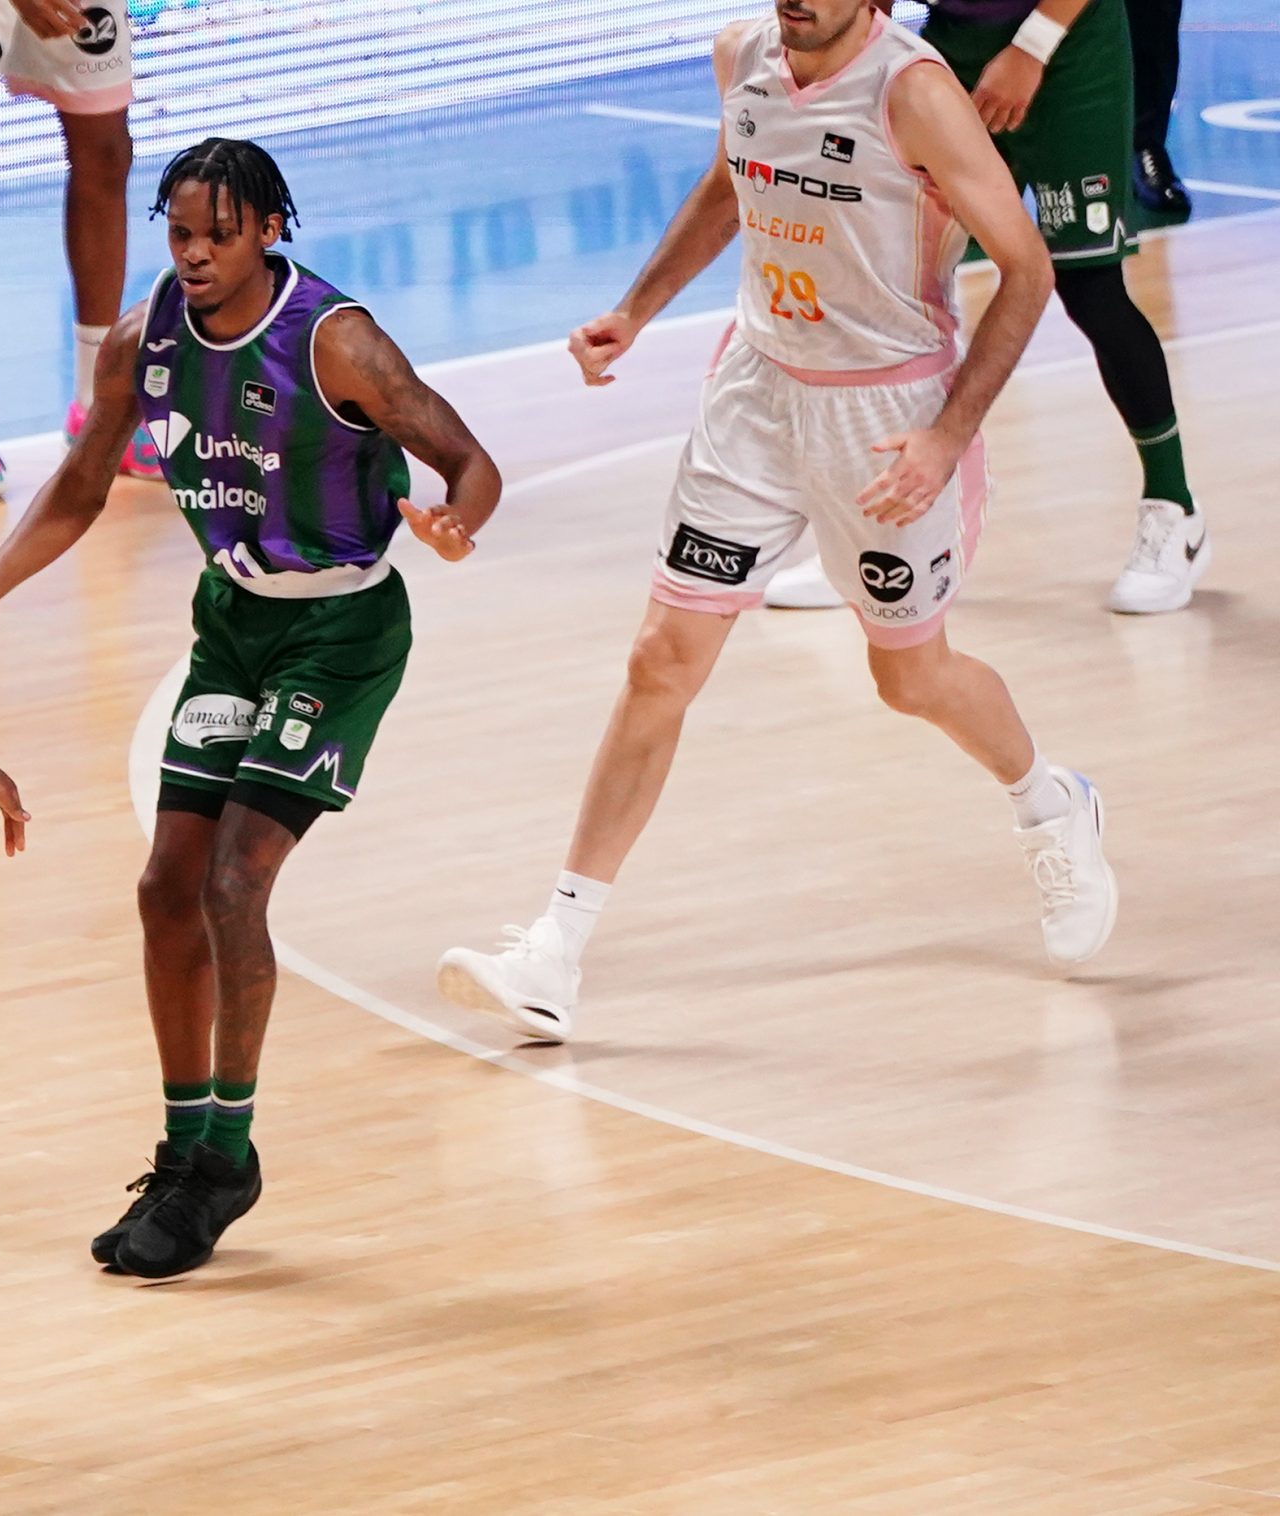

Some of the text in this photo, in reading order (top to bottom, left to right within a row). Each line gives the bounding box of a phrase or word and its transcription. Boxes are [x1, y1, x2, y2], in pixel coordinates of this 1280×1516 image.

[746, 207, 825, 246] LLEIDA
[761, 261, 825, 323] 29
[680, 538, 742, 578] PONS
[862, 598, 919, 619] CUDOS
